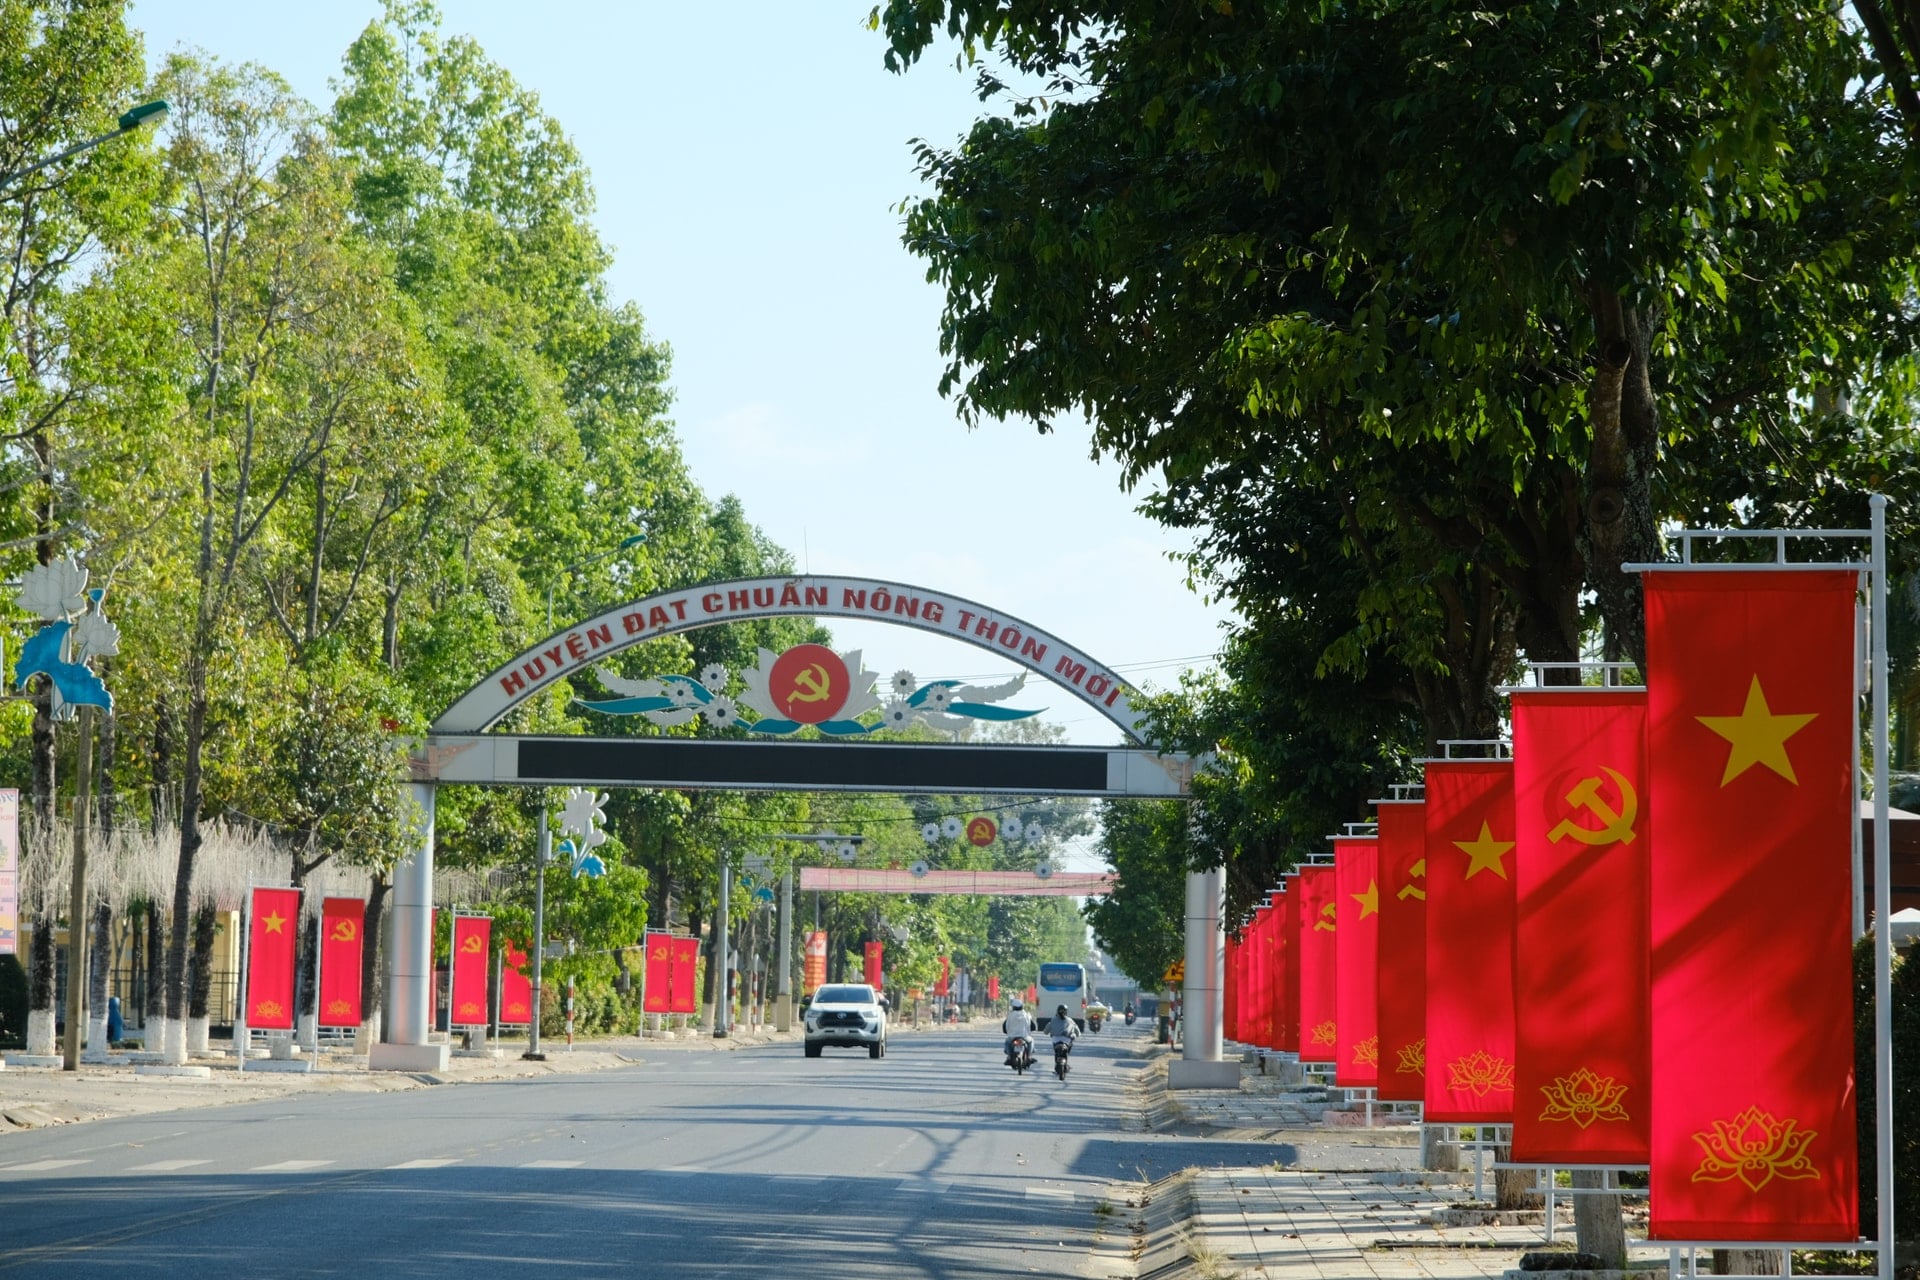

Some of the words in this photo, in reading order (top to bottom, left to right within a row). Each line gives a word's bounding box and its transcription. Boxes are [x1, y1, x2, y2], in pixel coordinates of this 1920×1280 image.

[499, 624, 613, 697] HUYỆN
[622, 599, 688, 635] ĐẠT
[702, 578, 828, 614] CHUẨN
[843, 587, 945, 623] NÔNG
[957, 609, 1048, 663] THÔN
[1054, 655, 1122, 708] MỚI
